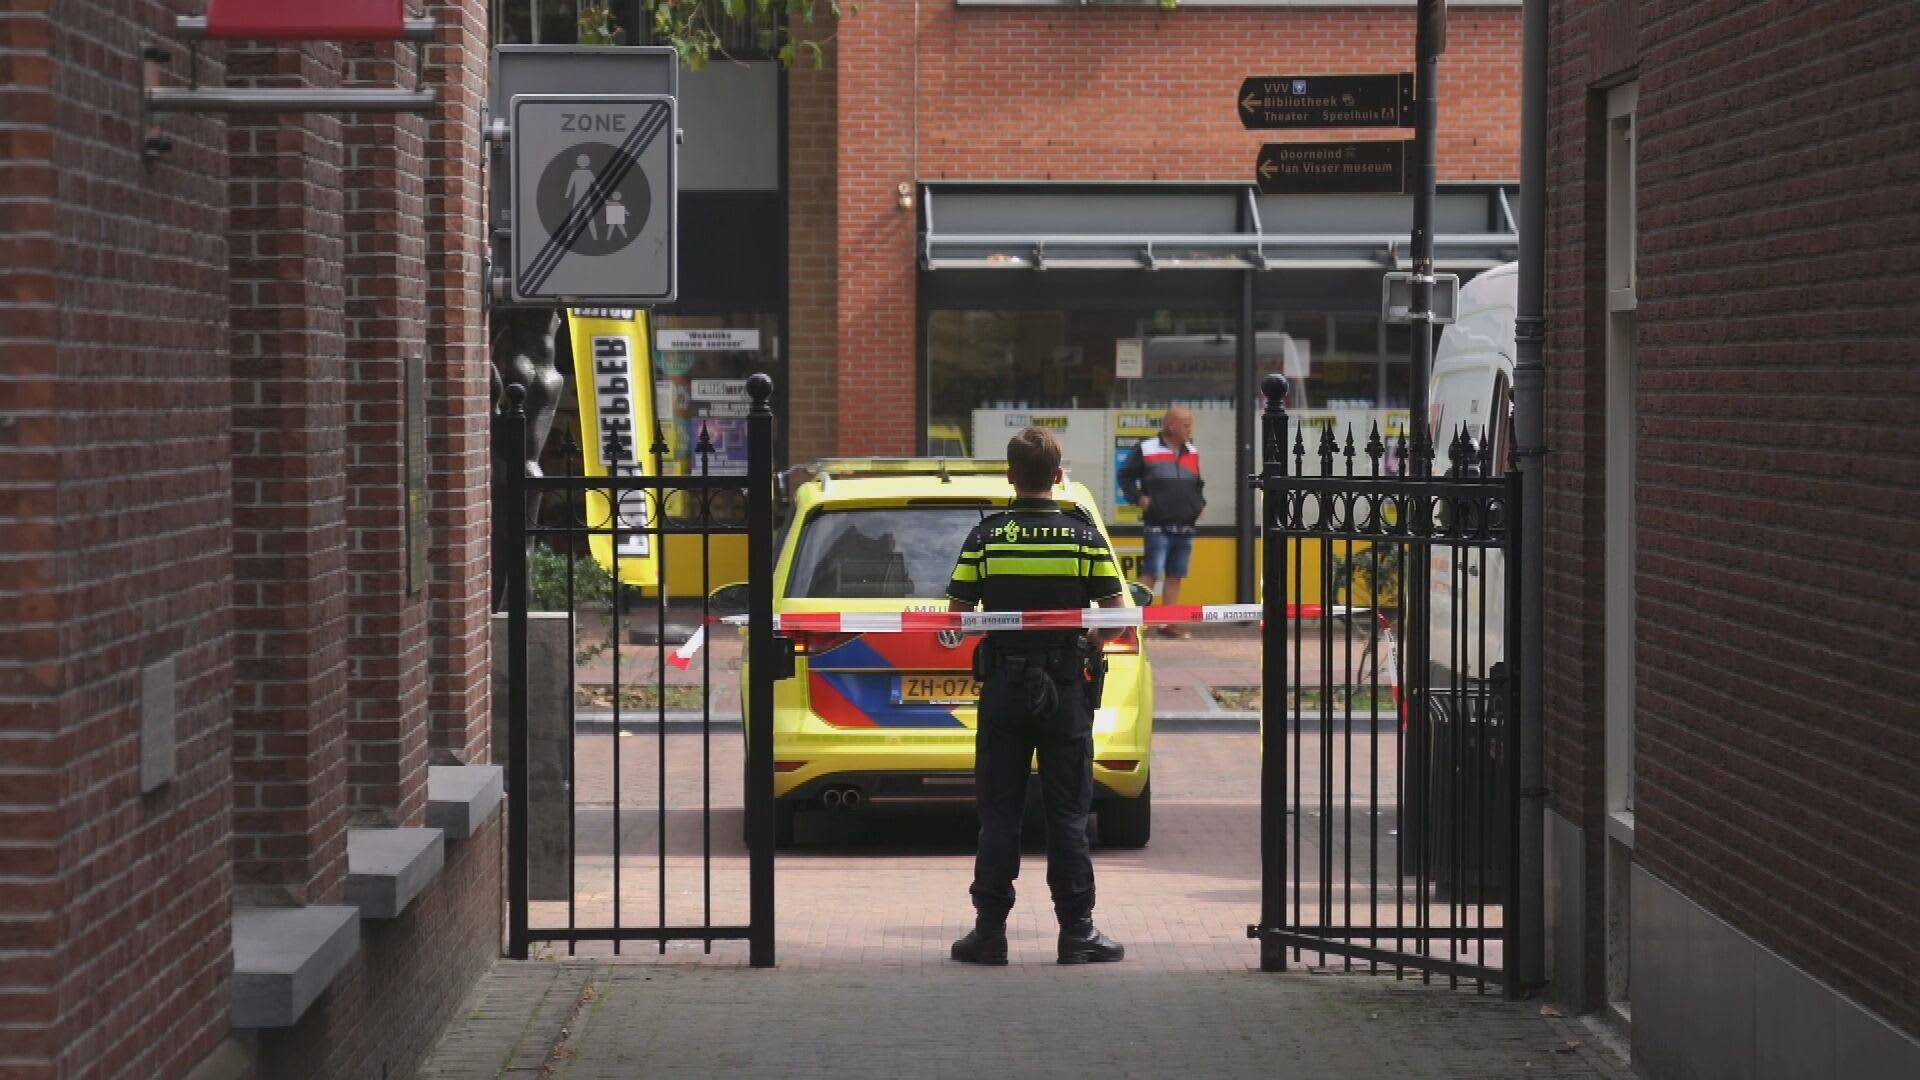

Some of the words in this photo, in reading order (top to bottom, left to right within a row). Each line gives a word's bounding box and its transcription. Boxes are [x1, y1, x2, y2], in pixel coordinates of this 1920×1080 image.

[1264, 83, 1289, 93] VVV
[1264, 95, 1337, 107] Bibliotheek
[1264, 111, 1310, 121] Theater
[1322, 109, 1379, 123] Speelhuis
[561, 113, 626, 132] ZONE
[1281, 148, 1342, 161] Doorneind
[1303, 162, 1339, 173] Visser
[1344, 163, 1393, 174] museum
